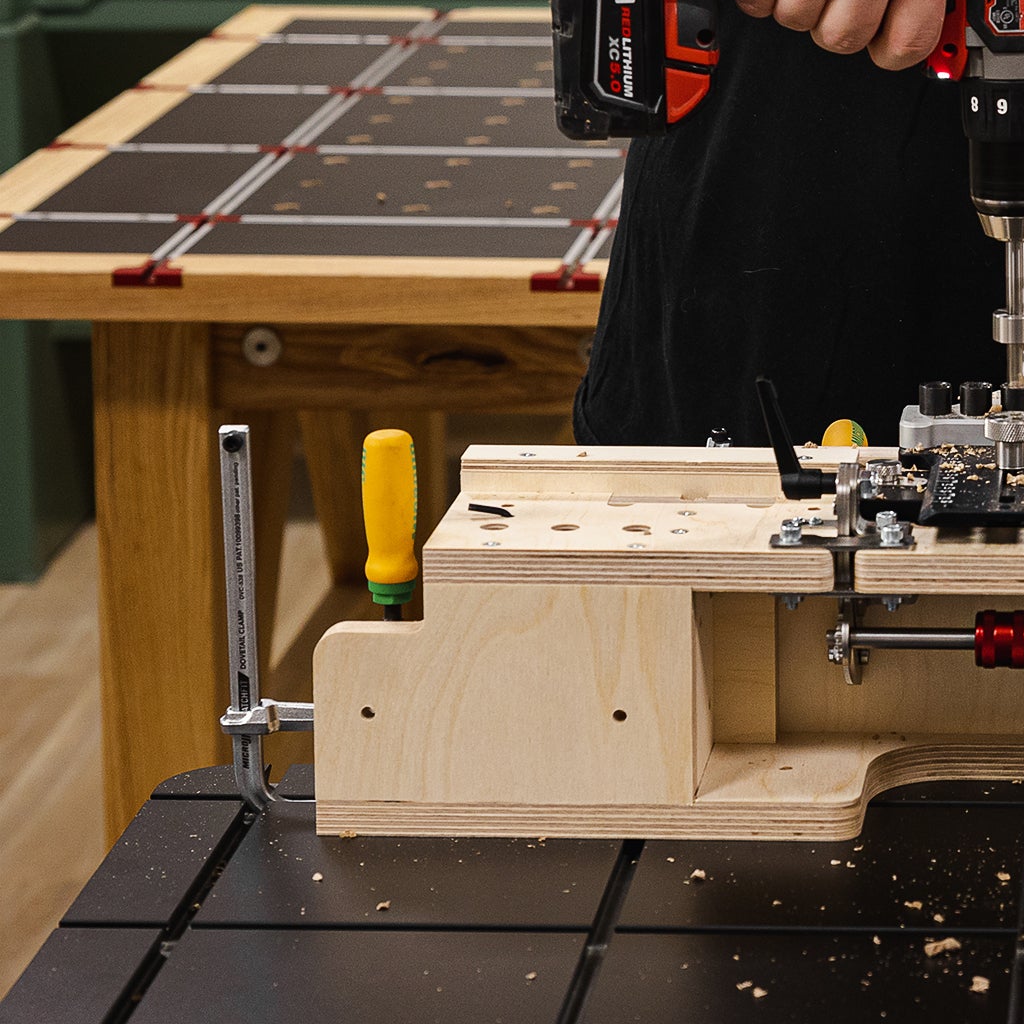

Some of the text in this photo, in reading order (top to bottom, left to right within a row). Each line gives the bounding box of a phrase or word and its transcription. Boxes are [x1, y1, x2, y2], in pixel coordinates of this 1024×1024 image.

[621, 7, 633, 98] REDLITHIUM
[237, 562, 243, 572] US
[240, 680, 249, 711] ATCHFIT
